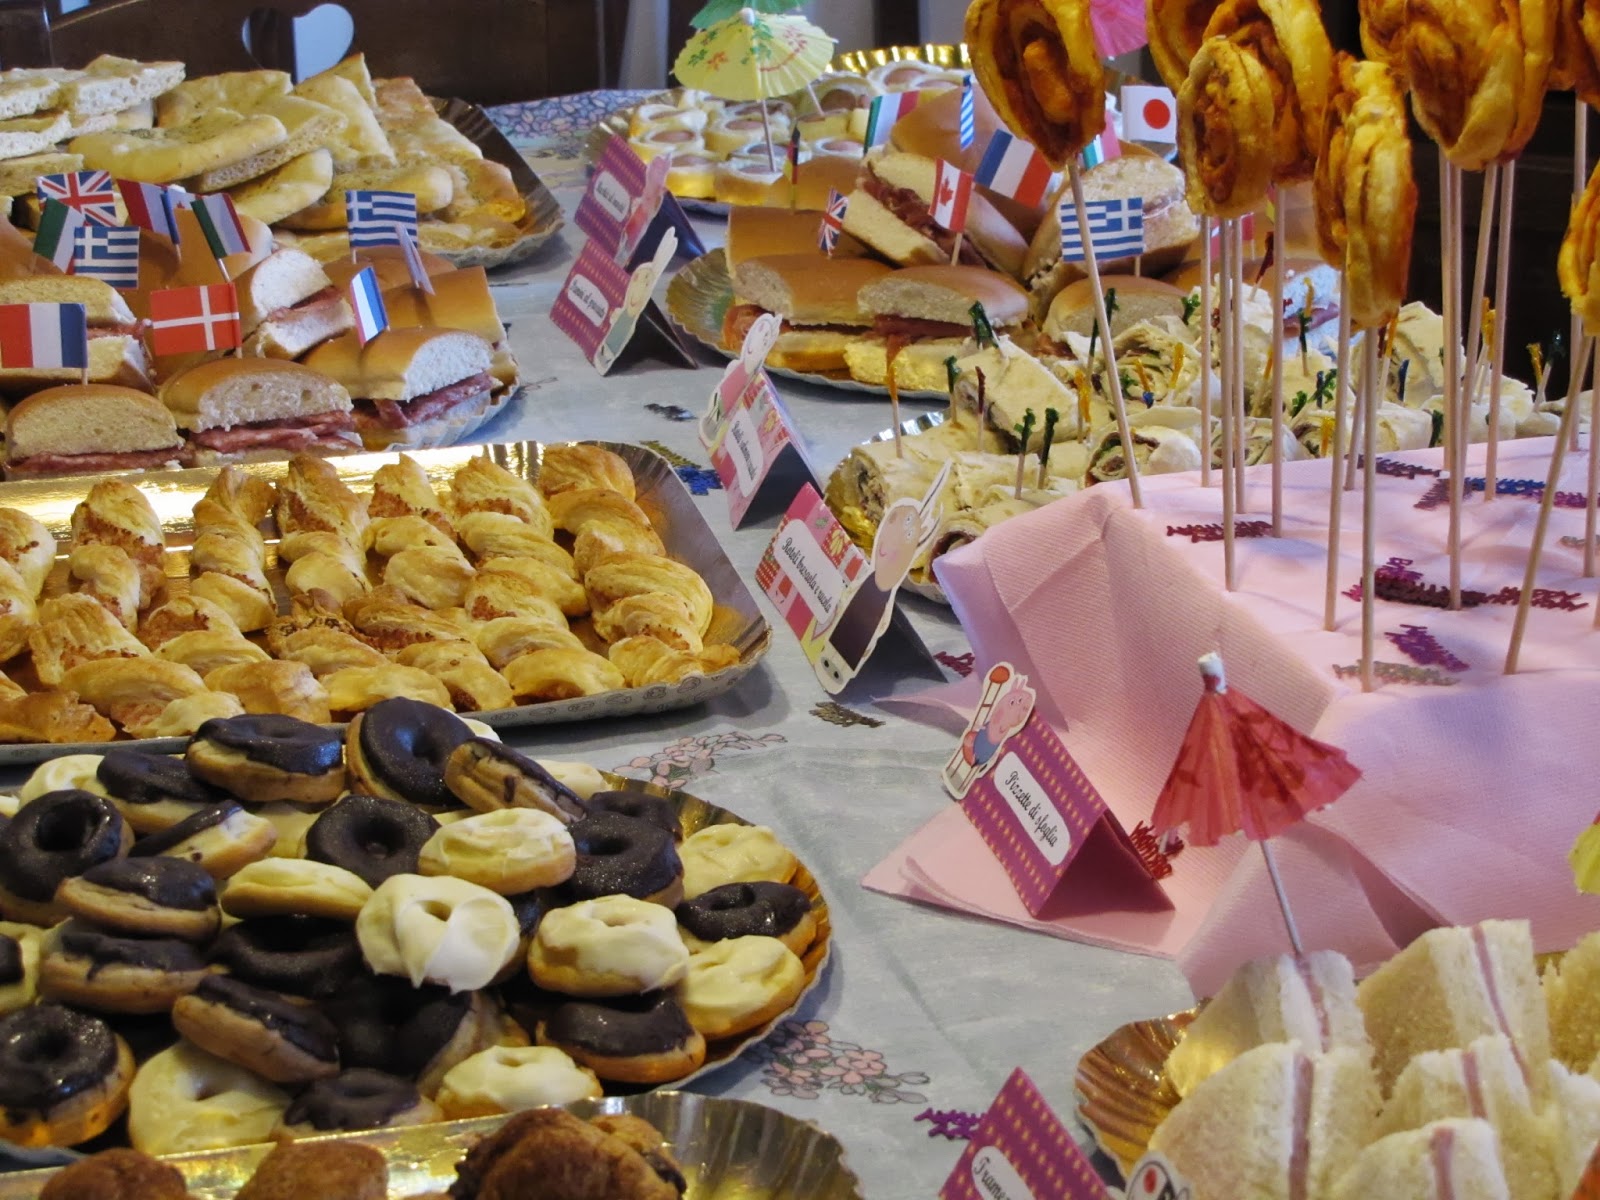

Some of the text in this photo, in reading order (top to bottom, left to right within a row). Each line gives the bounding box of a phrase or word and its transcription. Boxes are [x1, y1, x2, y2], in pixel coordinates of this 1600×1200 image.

[781, 537, 801, 566] Rotoli
[1005, 771, 1057, 847] Pizzette di sfoglia
[974, 1156, 1011, 1200] Trame
